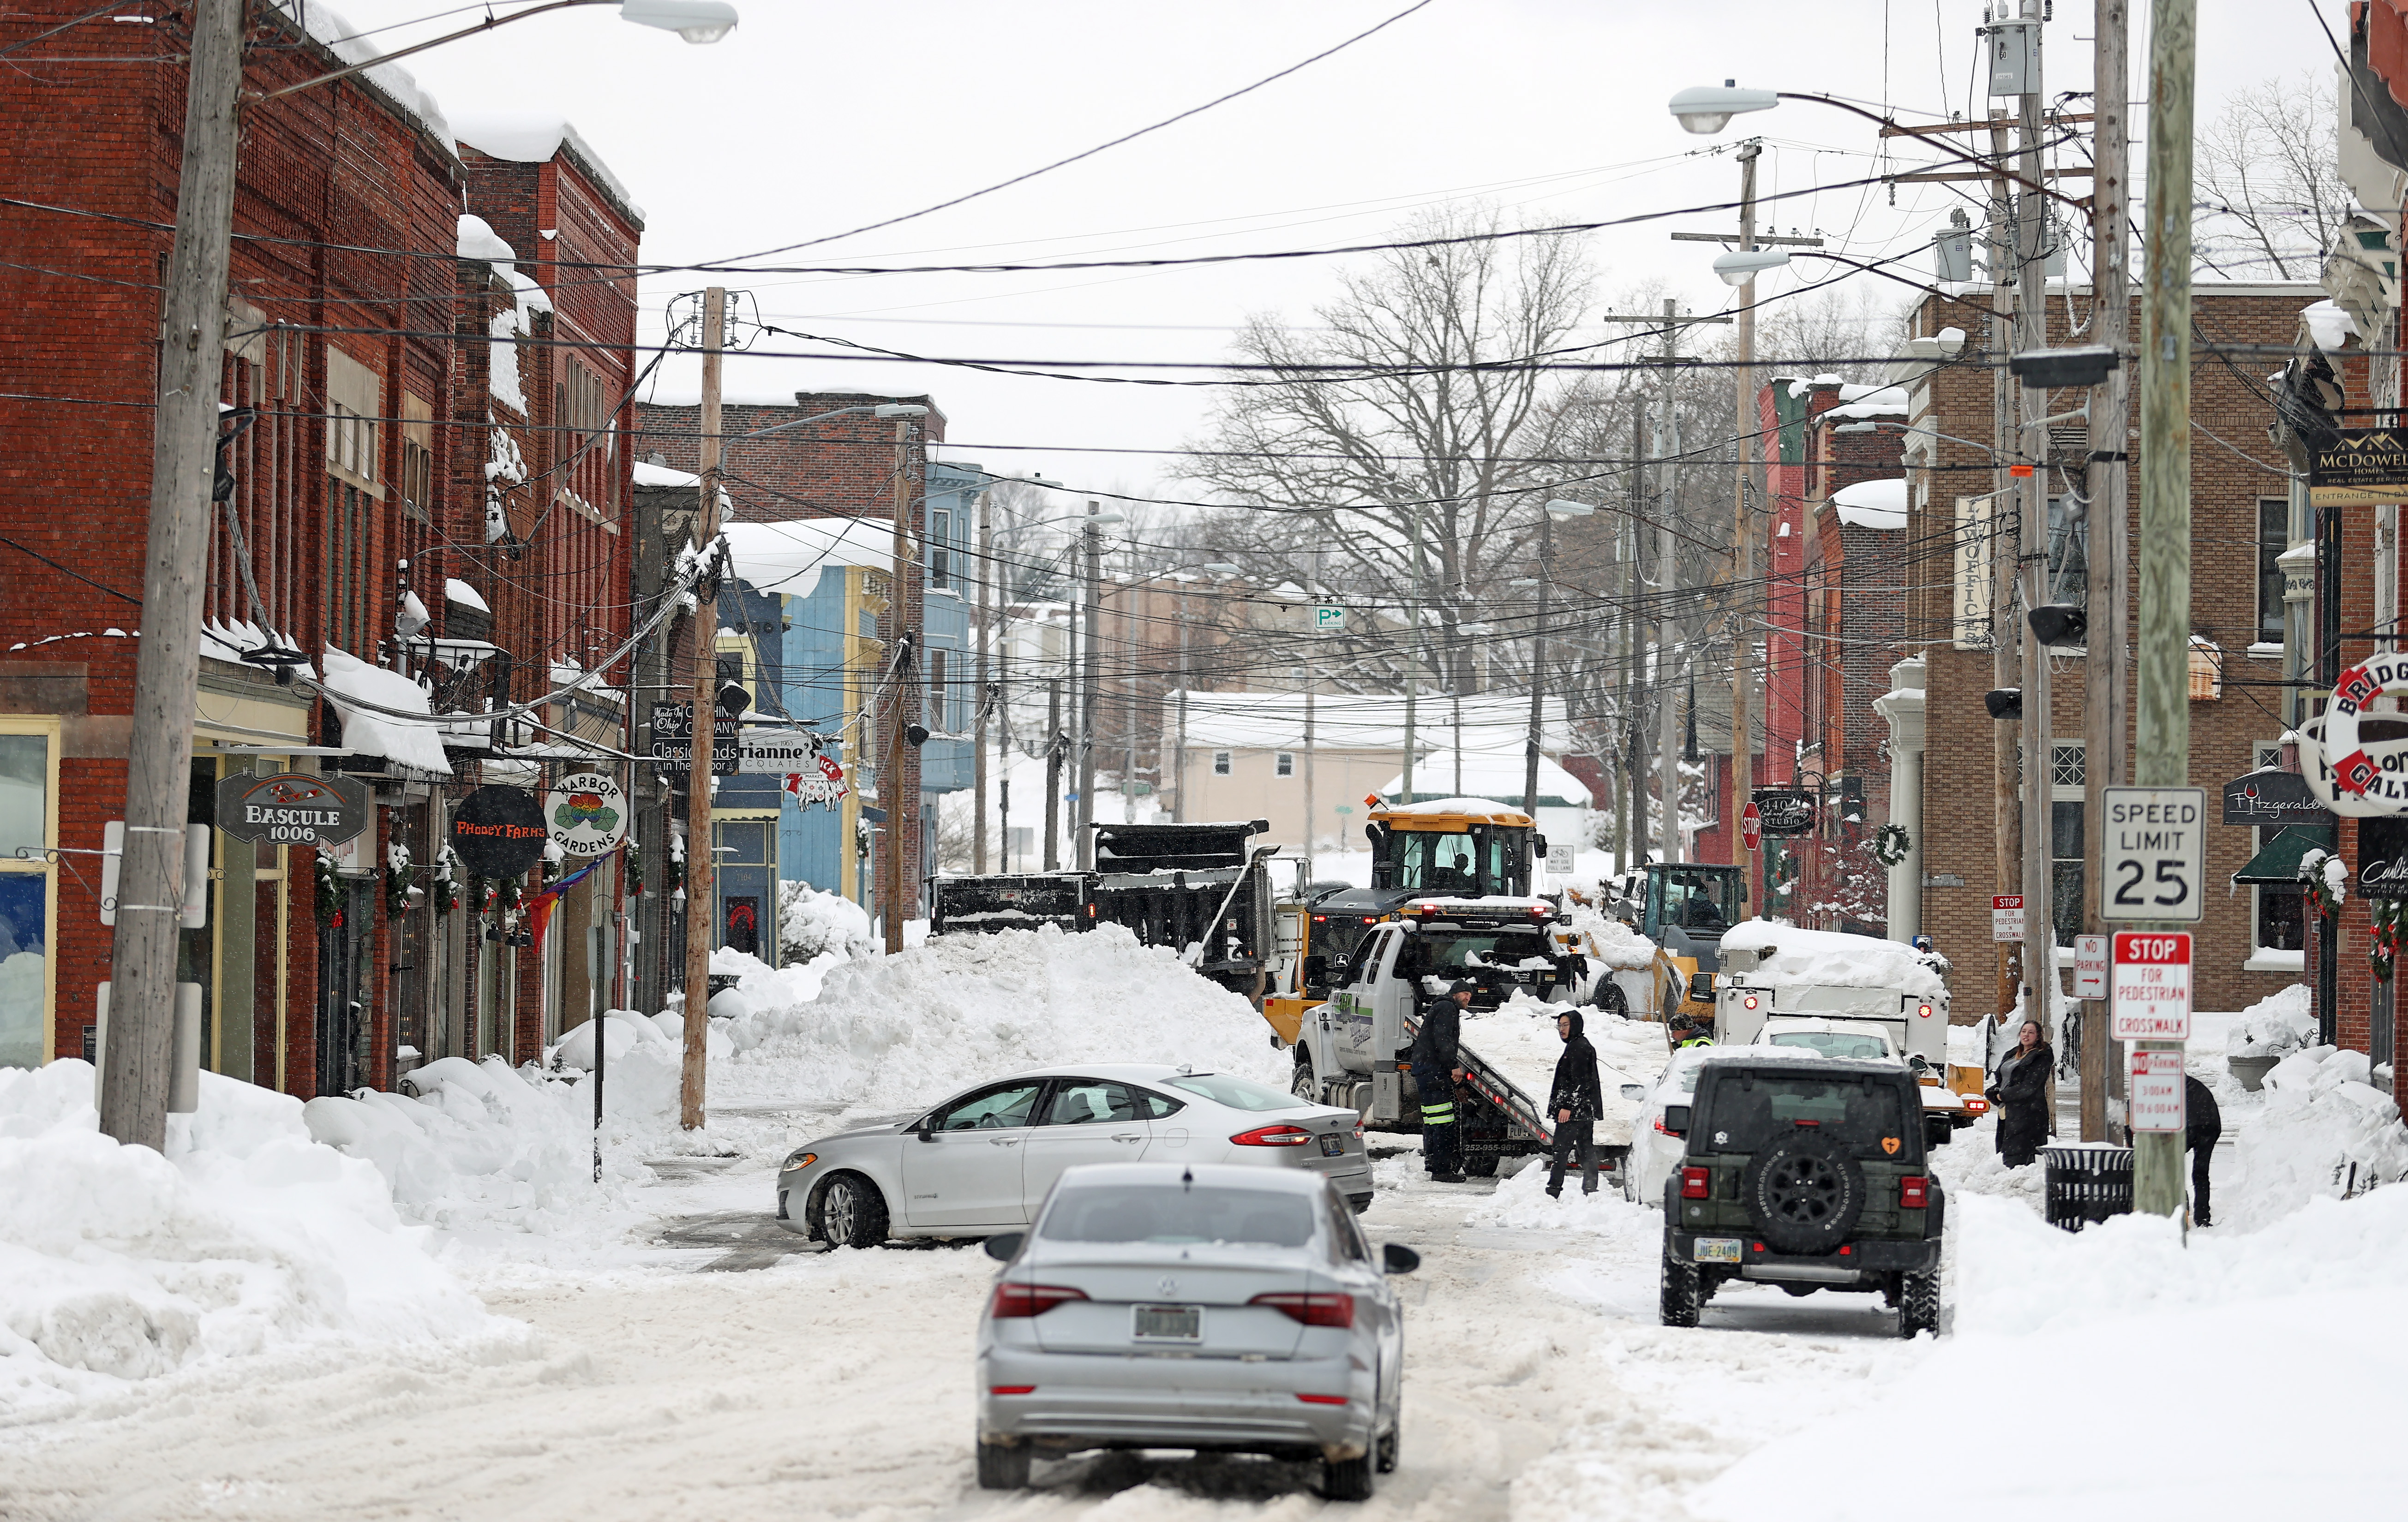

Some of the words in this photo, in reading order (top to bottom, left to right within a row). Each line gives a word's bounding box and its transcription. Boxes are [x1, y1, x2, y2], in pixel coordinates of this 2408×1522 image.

[2316, 492, 2374, 500] ENTRANCE
[653, 707, 673, 718] Made
[674, 706, 683, 718] In
[656, 717, 680, 730] Ohio
[674, 760, 691, 770] The
[558, 776, 619, 799] HARBOR
[1763, 800, 1788, 810] 440
[246, 806, 340, 826] BASCULE
[2112, 804, 2195, 823] SPEED
[505, 824, 545, 839] FARMS
[1743, 817, 1760, 835] STOP
[271, 826, 316, 842] 1006
[2120, 831, 2185, 850] LIMIT
[554, 831, 615, 853] GARDENS
[2114, 859, 2188, 906] 25
[1999, 898, 2020, 907] STOP
[2085, 941, 2097, 953] NO
[2128, 938, 2177, 960] STOP
[2077, 960, 2104, 972] PARKING
[2141, 968, 2163, 983] FOR
[2118, 985, 2186, 1001] PEDESTRIAN
[2148, 1004, 2156, 1015] IN
[2119, 1017, 2183, 1033] CROSSWALK
[2133, 1055, 2147, 1071] NO
[2149, 1058, 2179, 1069] PARKING
[1697, 1245, 1713, 1257] JUE
[1717, 1246, 1737, 1258] 2409
